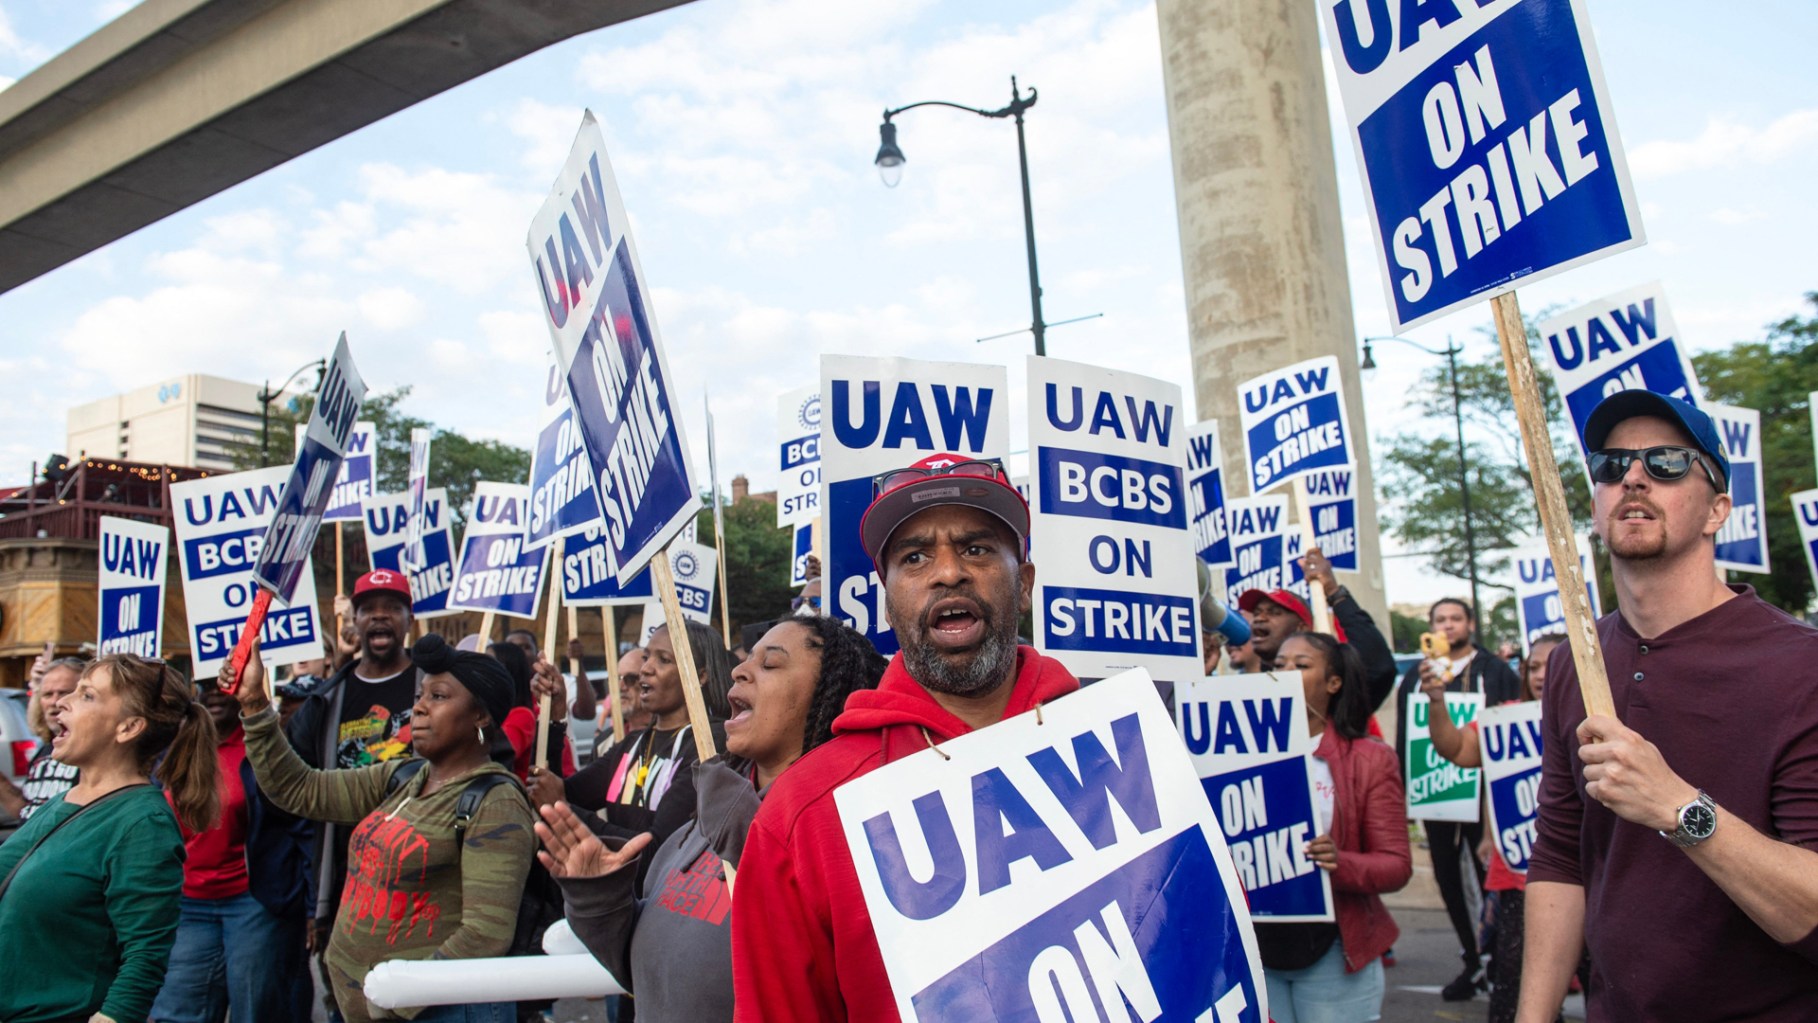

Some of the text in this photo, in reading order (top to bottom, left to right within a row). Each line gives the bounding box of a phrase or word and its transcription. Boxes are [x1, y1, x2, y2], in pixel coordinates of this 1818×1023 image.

[1333, 0, 1497, 74] UA
[1422, 43, 1506, 170] ON
[1392, 87, 1599, 303] STRIKE
[537, 150, 613, 329] UAW
[1548, 298, 1657, 371] UAW
[593, 305, 629, 424] ON
[319, 358, 358, 450] UAW
[1245, 366, 1329, 414] UAW
[832, 380, 993, 453] UAW
[1046, 382, 1173, 448] UAW
[1274, 404, 1310, 441] ON
[601, 346, 669, 551] STRIKE
[788, 440, 820, 465] BC
[1254, 420, 1342, 487] STRIKE
[303, 458, 331, 508] ON
[337, 461, 349, 484] N
[532, 450, 593, 535] STRIK
[1060, 461, 1172, 514] BCBS
[1306, 472, 1351, 496] UAW
[183, 483, 285, 526] UAW
[327, 478, 370, 511] RIKE
[475, 495, 527, 526] UA
[784, 492, 818, 515] STR
[1191, 482, 1206, 517] N
[1195, 507, 1227, 555] RIKE
[1318, 505, 1338, 534] ON
[1715, 503, 1758, 544] IKE
[104, 532, 160, 580] UAW
[198, 535, 265, 571] BCB
[486, 538, 522, 568] ON
[1089, 535, 1152, 578] ON
[1239, 543, 1262, 577] ON
[1315, 527, 1354, 558] TRIKE
[411, 561, 451, 604] RIKE
[456, 566, 538, 602] STRIKE
[565, 543, 616, 594] STRI
[118, 593, 141, 633] ON
[676, 585, 705, 609] CBS
[1544, 594, 1566, 622] O
[200, 611, 310, 653] STIKE
[1050, 598, 1192, 644] STRIKE
[1182, 697, 1293, 755] UAW
[1414, 702, 1476, 728] UW
[1426, 743, 1450, 768] O
[1220, 775, 1268, 837] ON
[1409, 766, 1477, 804] STRIKE
[862, 712, 1162, 920] UAW
[1227, 821, 1316, 892] RIKE
[1028, 899, 1163, 1023] ON
